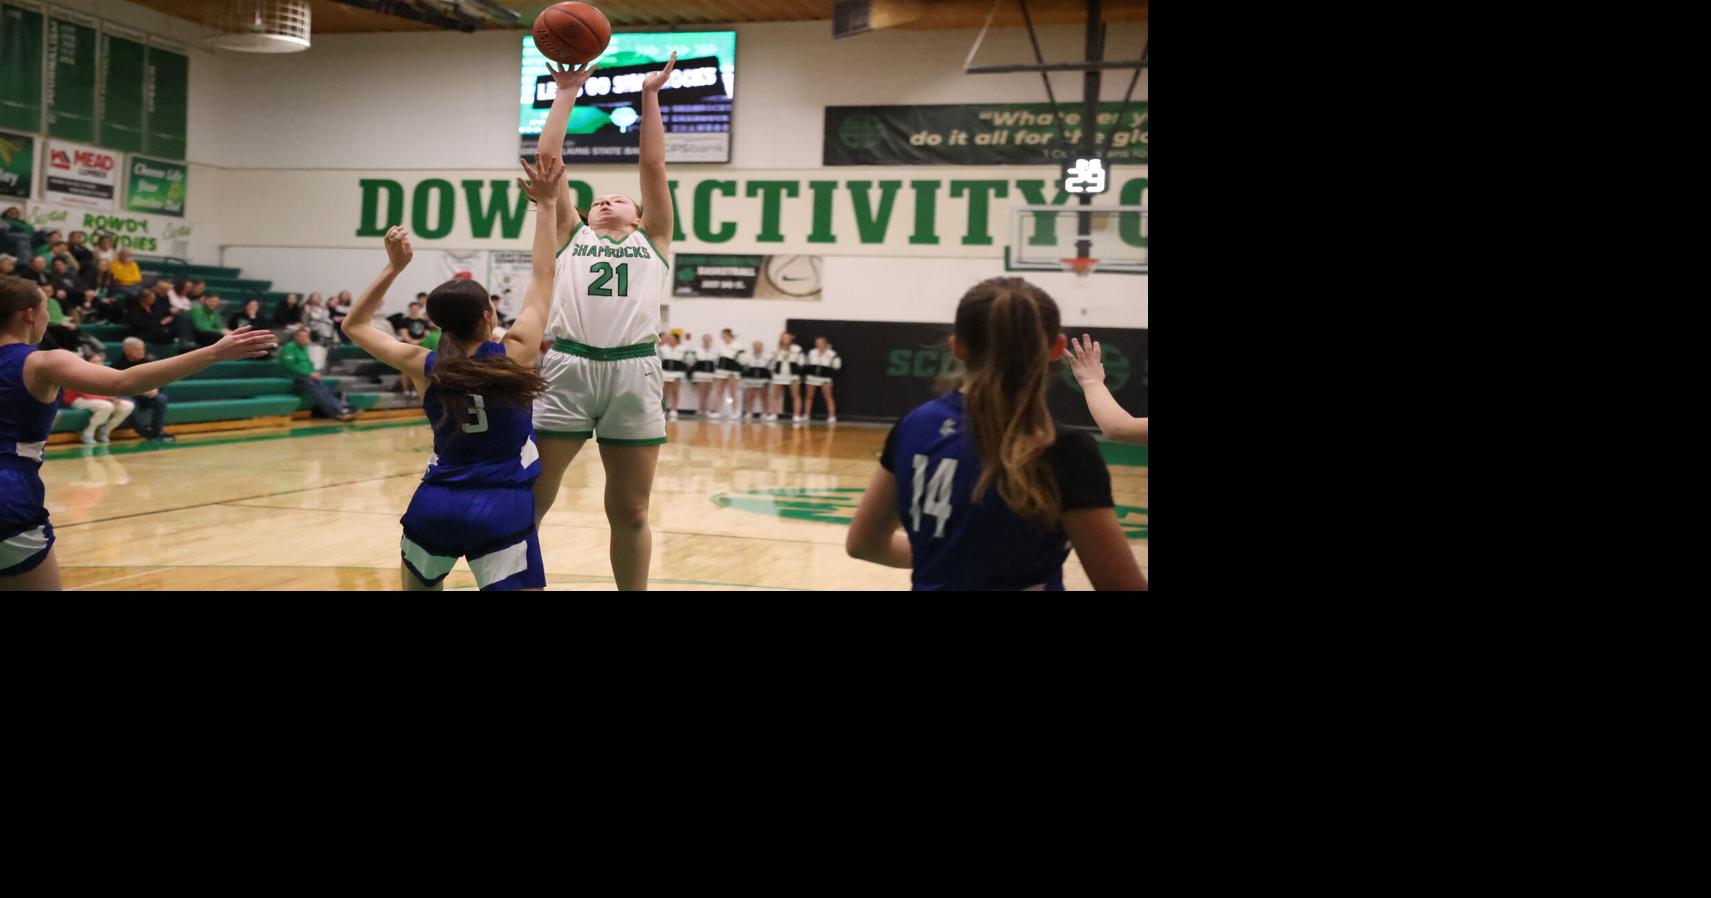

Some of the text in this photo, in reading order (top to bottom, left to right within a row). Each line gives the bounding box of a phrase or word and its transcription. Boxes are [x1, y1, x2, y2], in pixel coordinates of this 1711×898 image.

[910, 130, 942, 146] do
[949, 129, 968, 146] it
[974, 130, 1009, 146] all
[1014, 130, 1053, 146] for
[74, 150, 113, 171] MEAD
[83, 213, 149, 233] ROWDY
[572, 243, 651, 259] SHAMROCKS
[587, 261, 629, 297] 21
[461, 393, 489, 434] 3
[909, 453, 958, 538] 14
